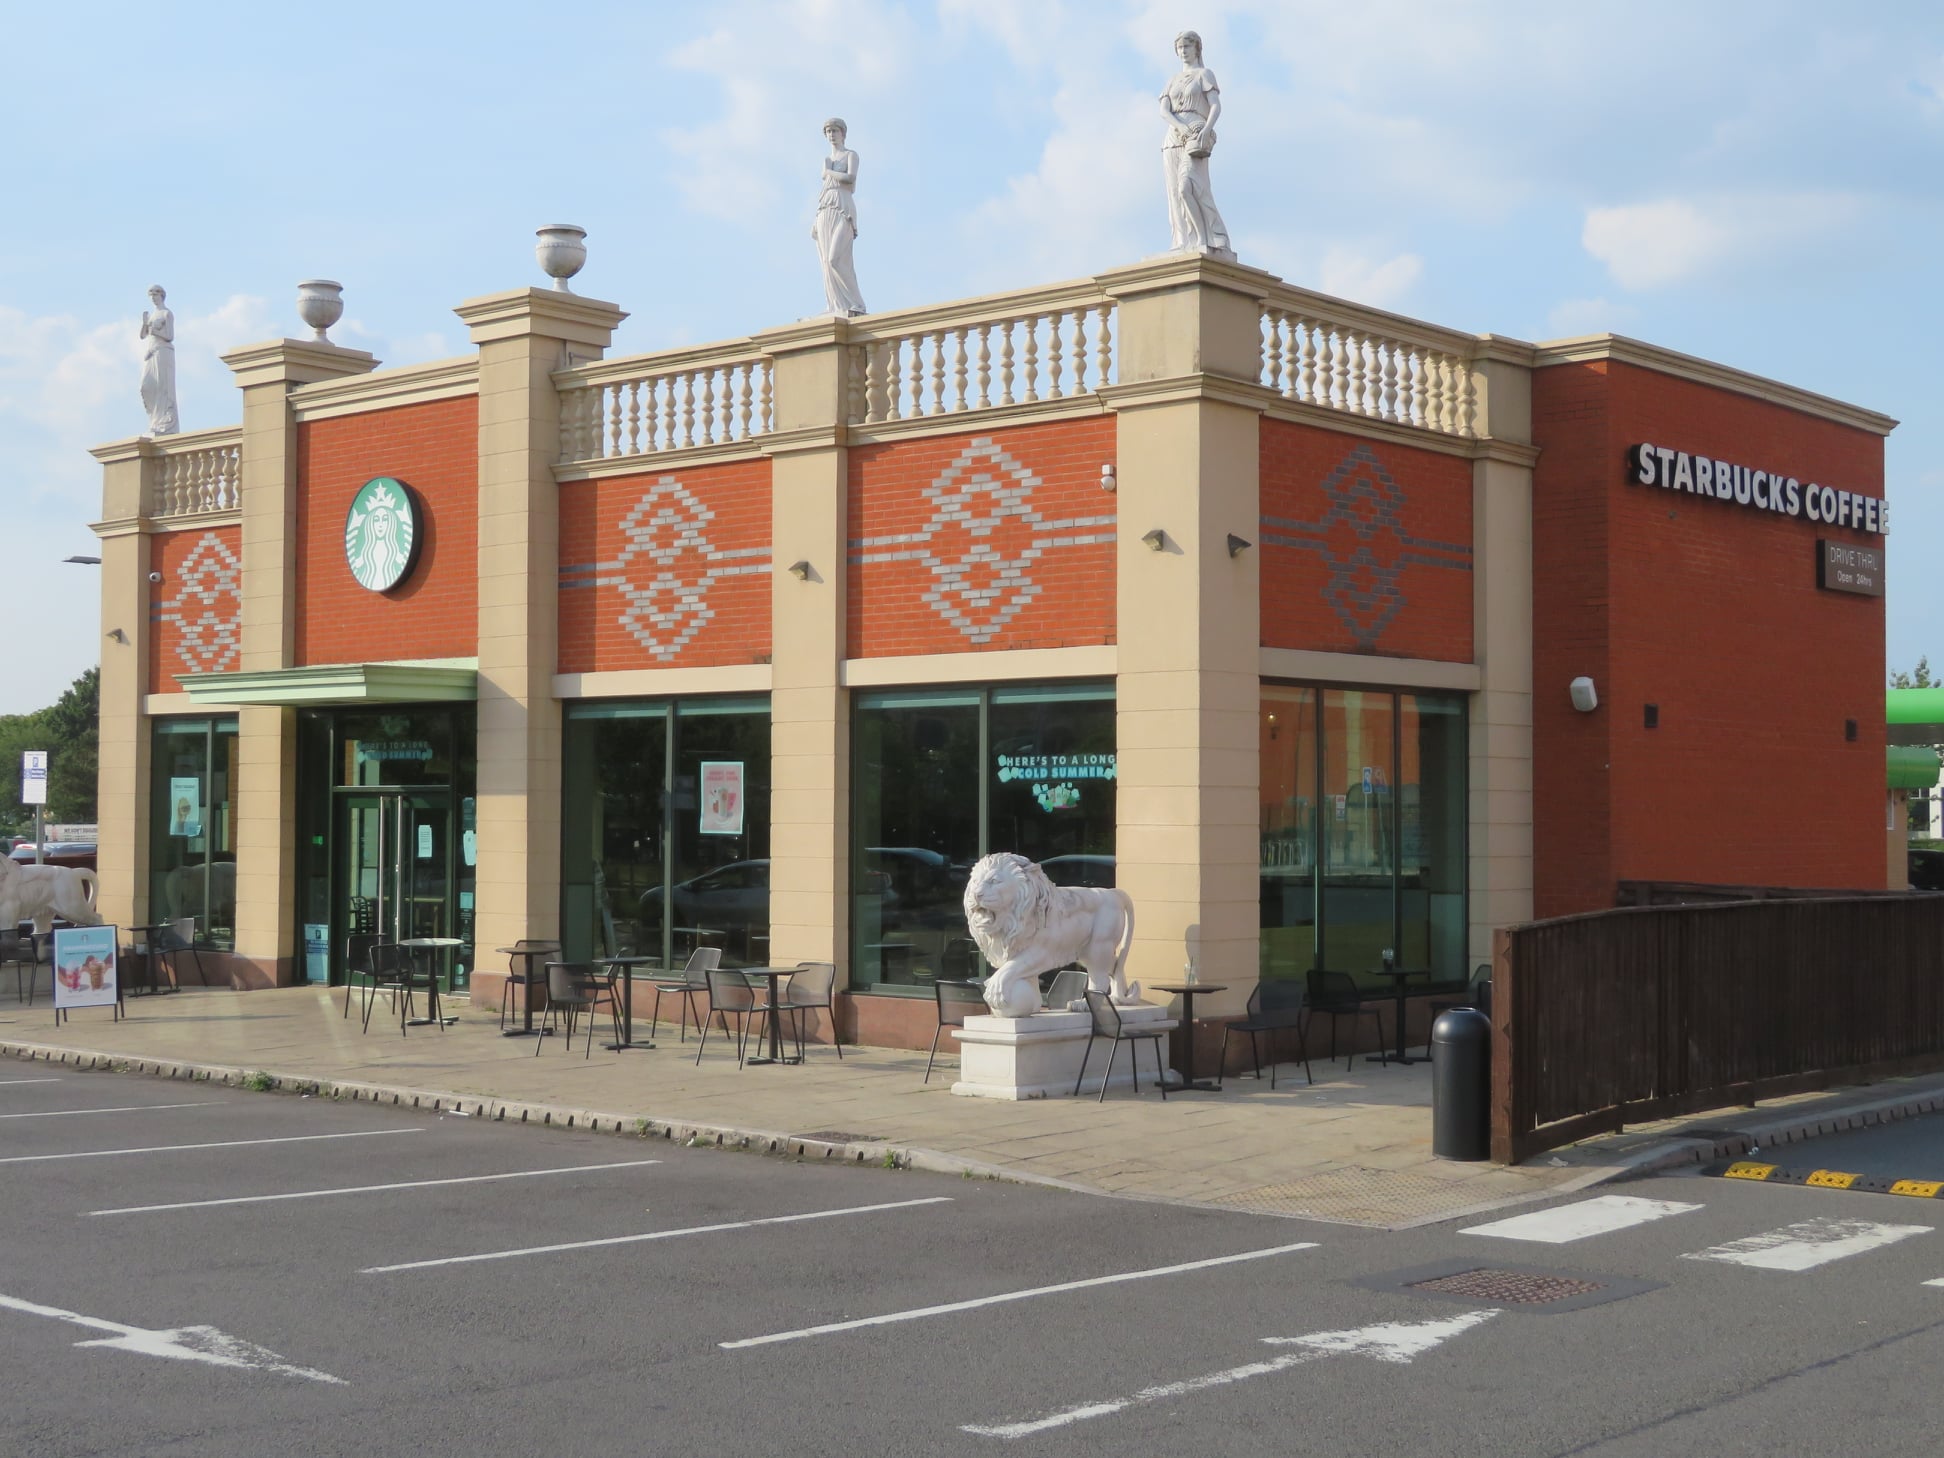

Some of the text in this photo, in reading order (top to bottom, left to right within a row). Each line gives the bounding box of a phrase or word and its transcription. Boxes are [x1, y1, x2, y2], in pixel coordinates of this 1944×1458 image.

[1638, 442, 1890, 535] STARBUCKS COFFEE
[1830, 546, 1855, 567] DRIVE
[1837, 570, 1853, 584] Open
[1007, 755, 1115, 766] HERE'S TO A LONG
[1018, 766, 1105, 779] COLD SUMMER
